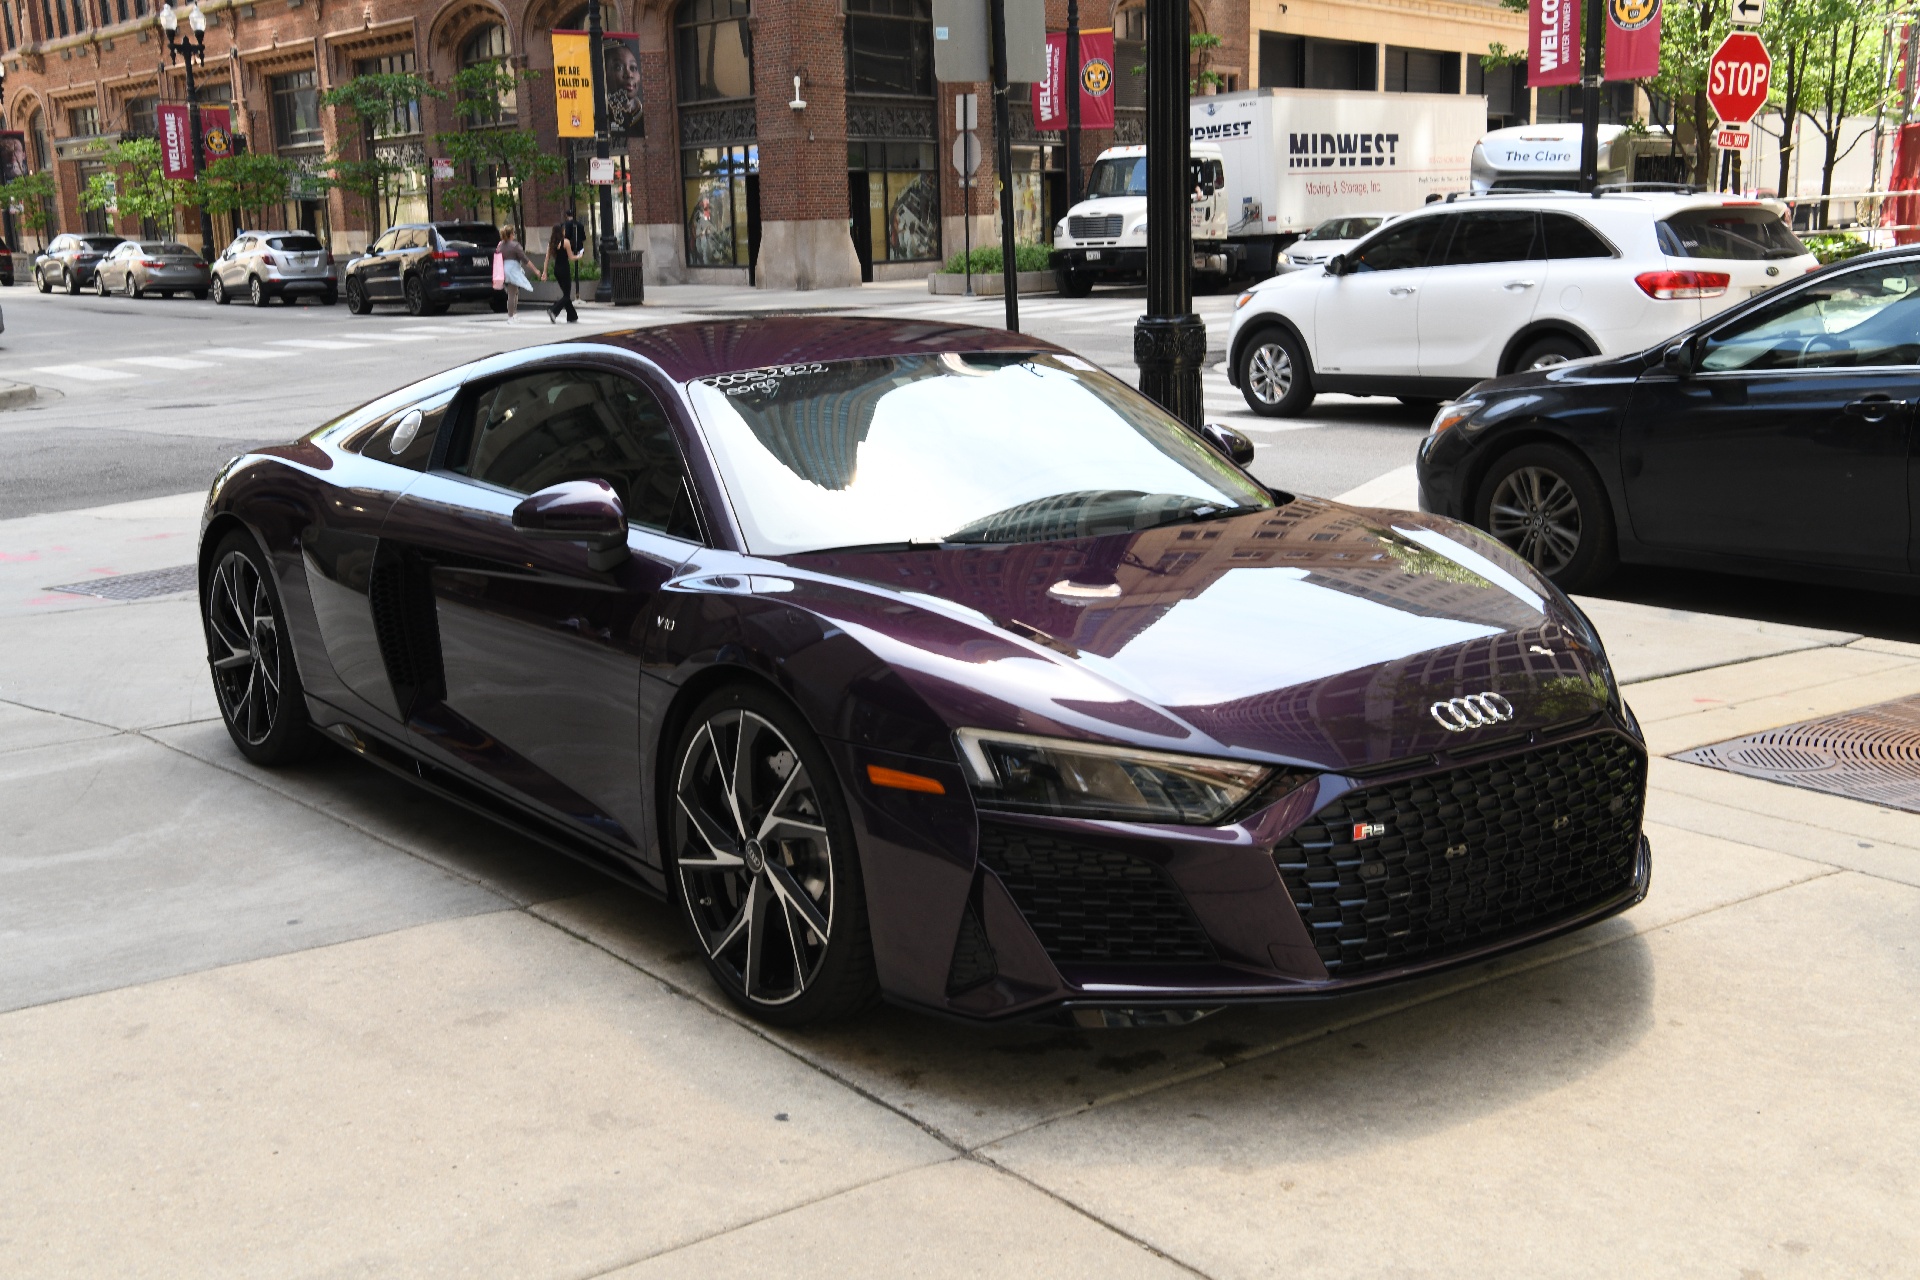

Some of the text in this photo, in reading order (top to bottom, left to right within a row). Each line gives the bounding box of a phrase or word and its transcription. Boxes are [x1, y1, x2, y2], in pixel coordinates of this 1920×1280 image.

[1562, 34, 1570, 65] WATER
[557, 66, 580, 76] WE ARE
[1712, 61, 1767, 96] STOP
[558, 78, 590, 88] CALLED TO
[559, 90, 577, 99] SOLVE
[1190, 121, 1252, 140] IDWEST
[164, 112, 181, 172] WELCOME
[1720, 134, 1748, 147] ALL WAY
[1289, 133, 1399, 168] MIDWEST
[1506, 151, 1571, 162] The Clare
[1306, 182, 1331, 197] Moving
[1340, 181, 1369, 196] Storage,
[1361, 823, 1385, 838] R8
